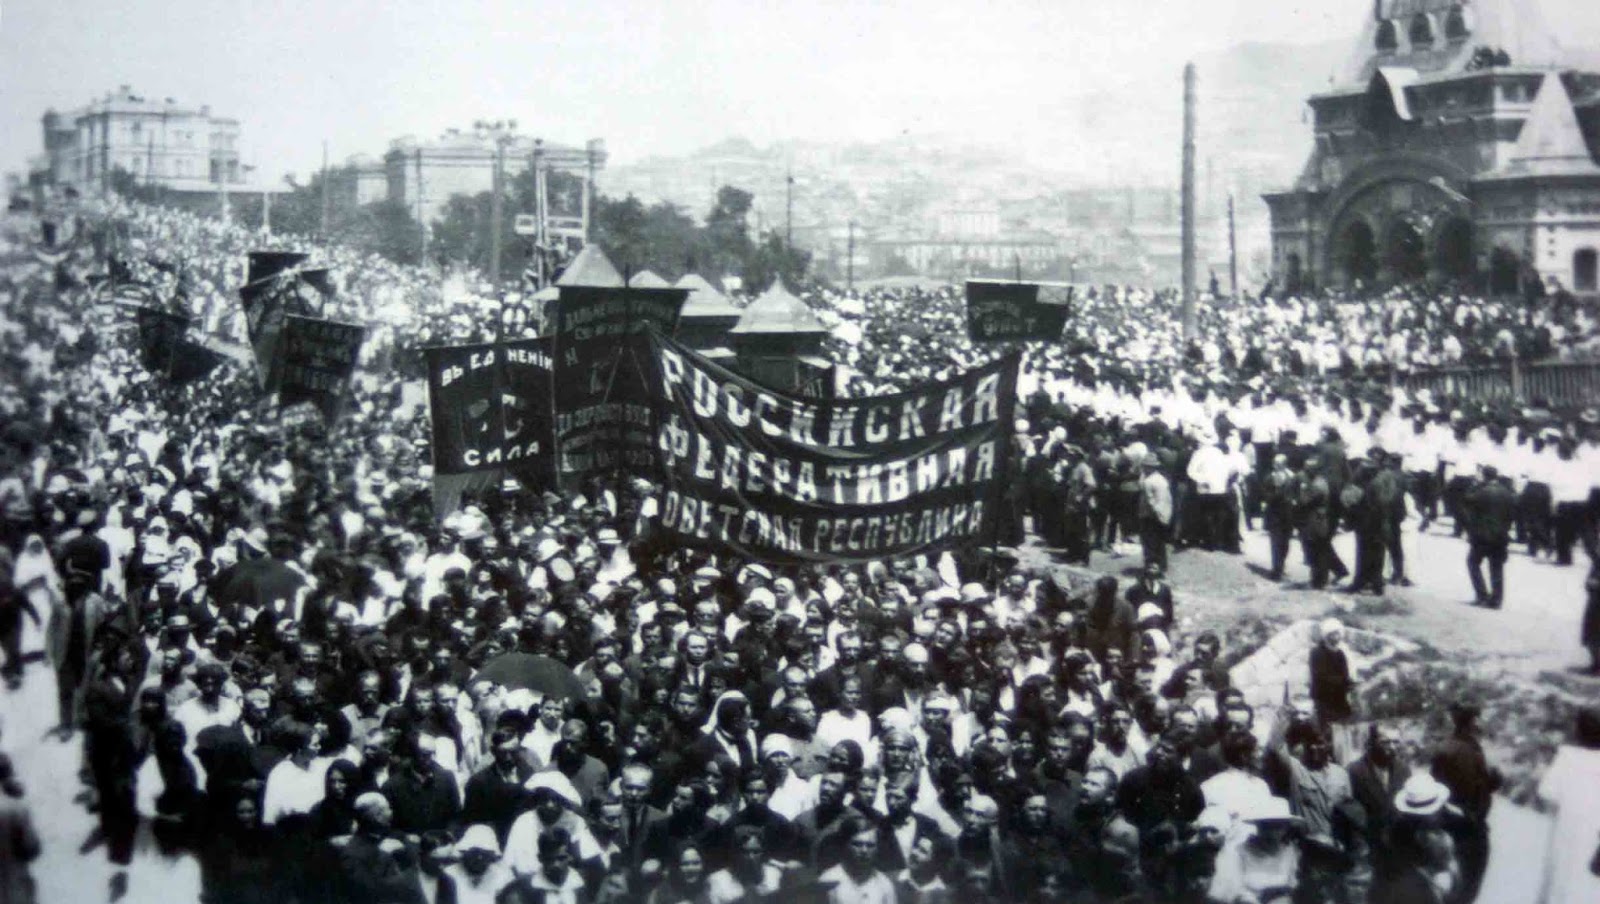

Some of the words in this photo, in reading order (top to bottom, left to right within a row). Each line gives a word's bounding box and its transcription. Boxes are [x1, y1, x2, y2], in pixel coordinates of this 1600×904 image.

[470, 348, 553, 371] ЕДНЕНІИ
[661, 348, 999, 447] РОССИЙСКАЯ
[463, 441, 540, 467] СИЛА
[658, 412, 996, 505] ФЕДЕРАТИВНАЯ
[661, 490, 802, 552] ОВЕТСКАЯ
[813, 501, 983, 552] РЕСПУБЛИКА
